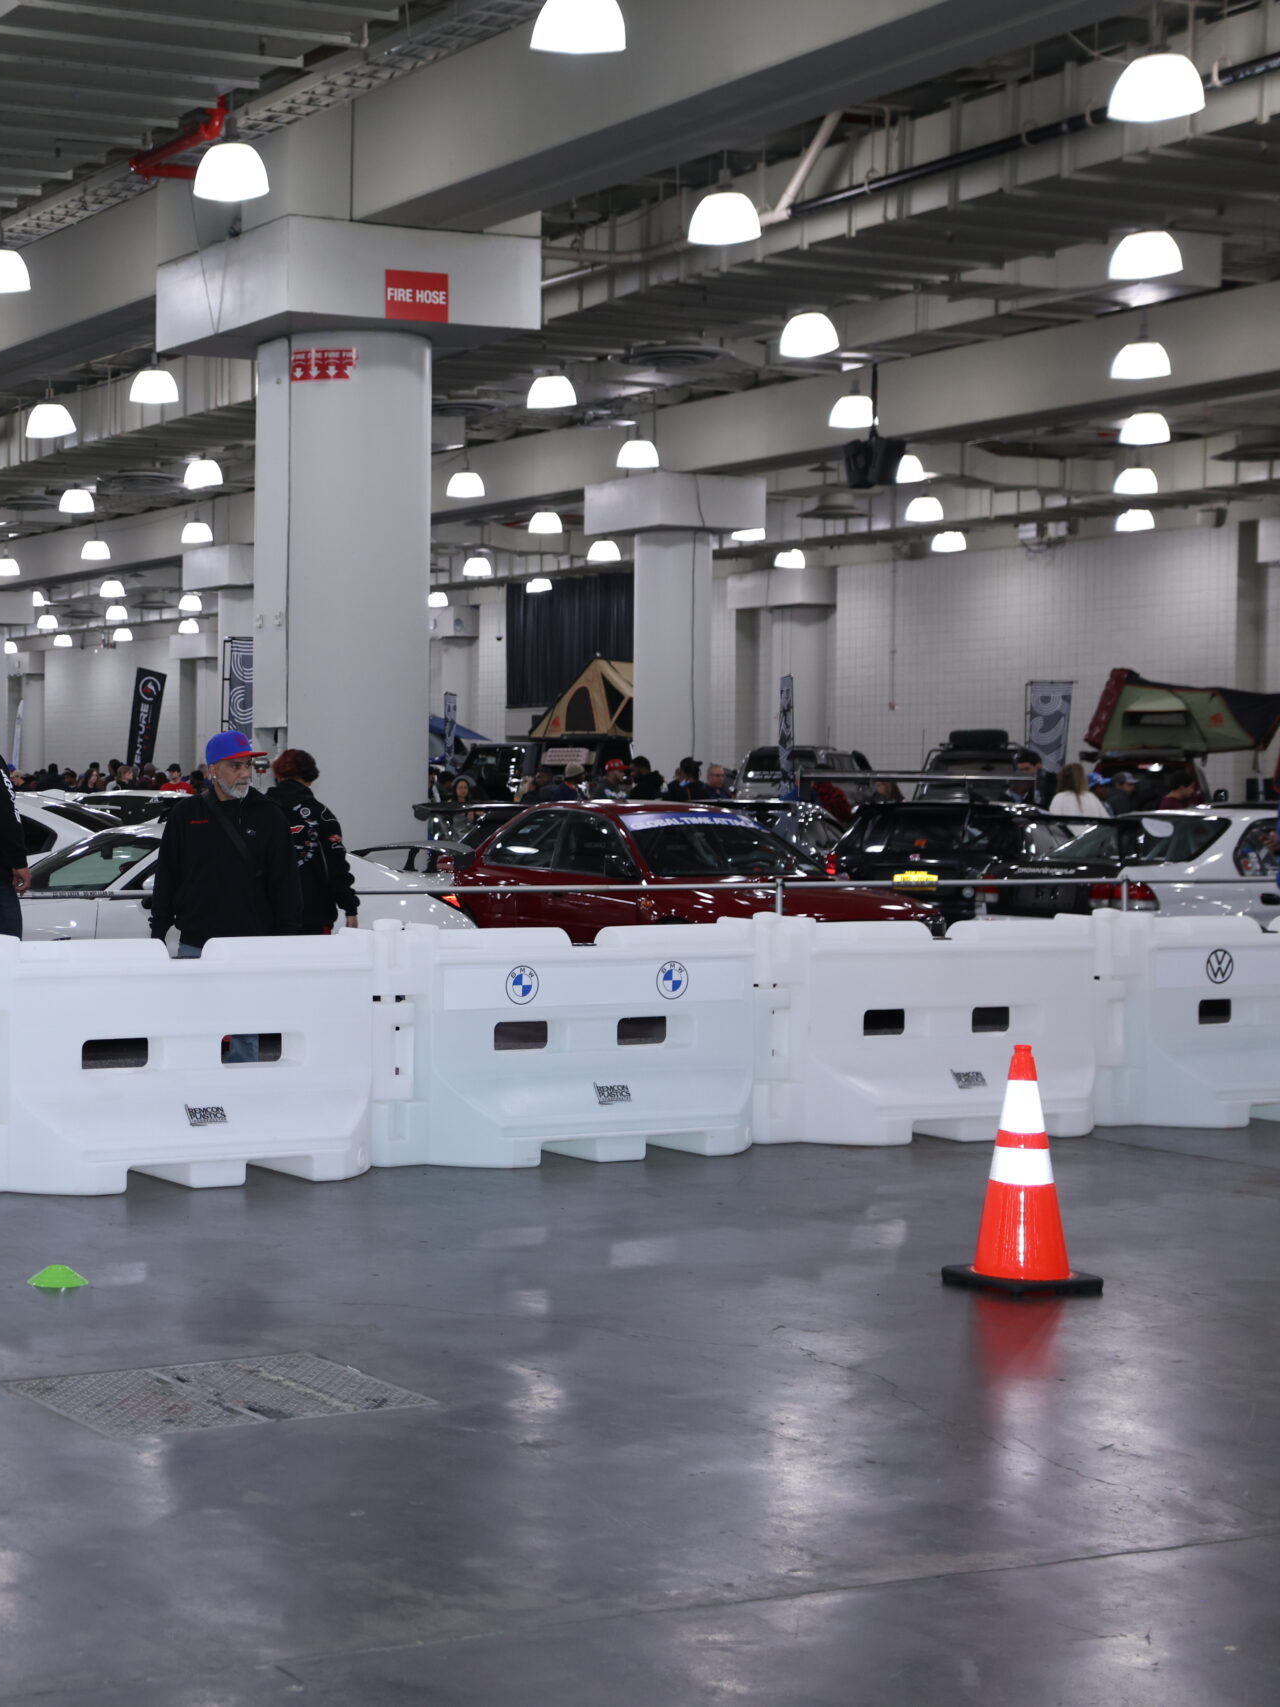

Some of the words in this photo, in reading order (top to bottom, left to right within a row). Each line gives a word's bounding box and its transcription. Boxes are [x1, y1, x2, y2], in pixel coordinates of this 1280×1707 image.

[387, 287, 413, 302] FIRE
[416, 290, 446, 304] HOSE
[630, 817, 684, 830] GLOBAL
[679, 816, 713, 825] TIME
[510, 967, 535, 979] BMW
[661, 963, 684, 974] BMW
[596, 1084, 629, 1092] REMCON
[187, 1106, 224, 1114] REMCON
[190, 1112, 227, 1120] PLASTICS
